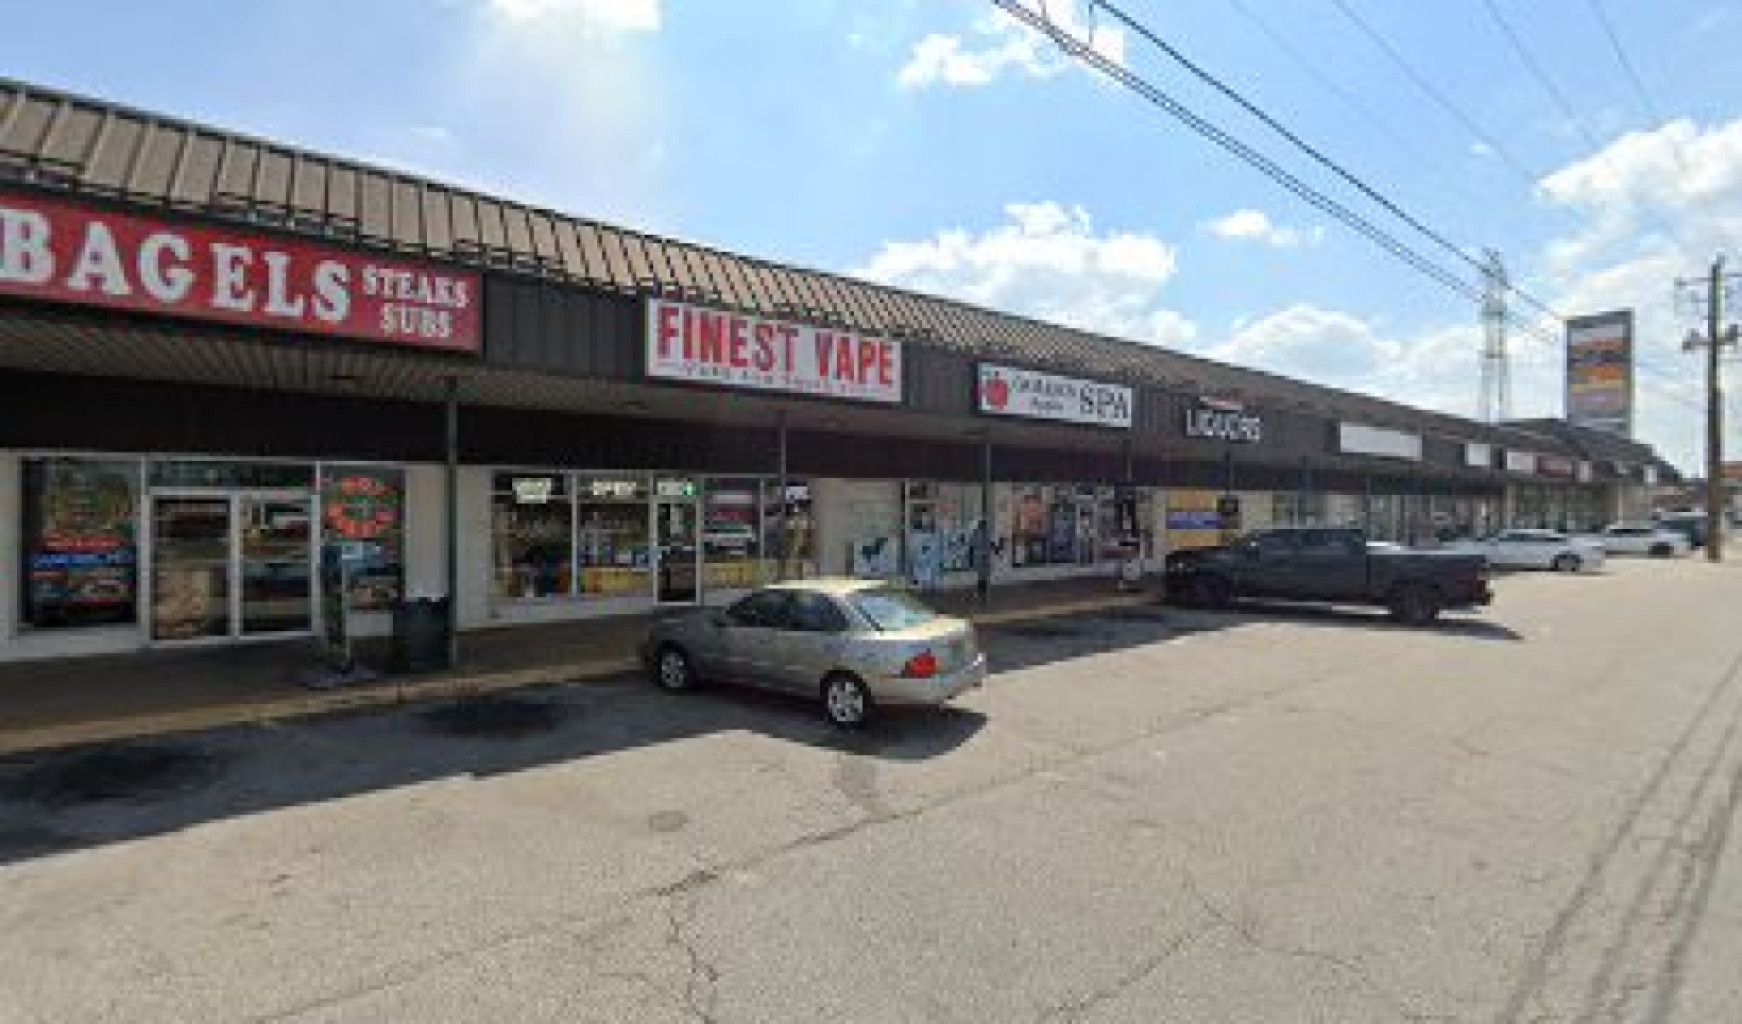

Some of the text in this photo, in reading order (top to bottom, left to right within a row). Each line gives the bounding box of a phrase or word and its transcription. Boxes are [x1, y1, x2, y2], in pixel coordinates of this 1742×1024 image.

[0, 206, 352, 324] BAGELS
[361, 264, 470, 309] STEAKS
[379, 302, 452, 339] SUBS
[656, 305, 800, 373] FINEST
[814, 331, 894, 386] VAPE
[1079, 384, 1130, 420] SPA
